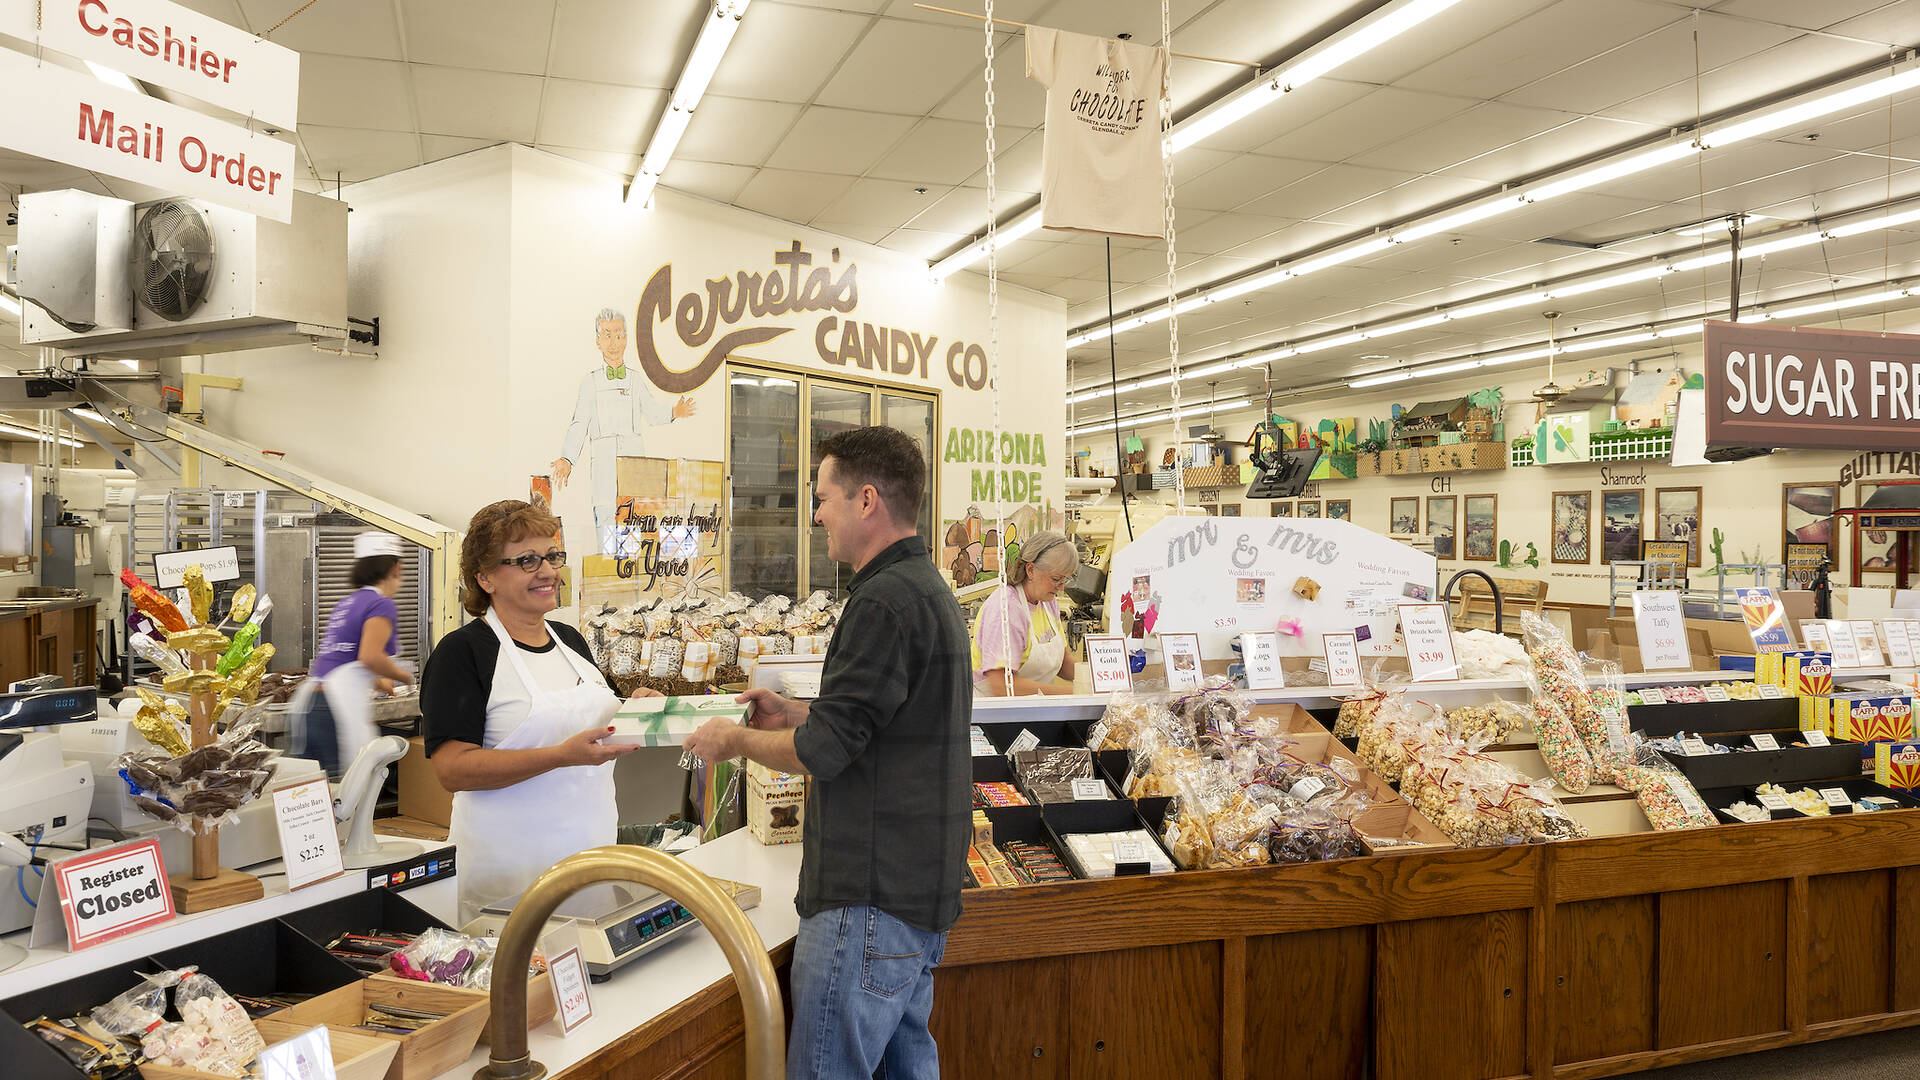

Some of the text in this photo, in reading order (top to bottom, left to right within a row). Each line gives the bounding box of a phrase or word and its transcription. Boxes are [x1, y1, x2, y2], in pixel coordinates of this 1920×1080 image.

[77, 0, 237, 84] Cashier
[1070, 88, 1145, 123] CHOCOLAE
[77, 102, 282, 196] Mail Order
[636, 240, 857, 394] Cerreta's
[815, 316, 938, 379] CANDY
[1726, 350, 1859, 419] SUGAR
[944, 427, 1047, 468] ARIZONA
[1600, 466, 1647, 486] Shamrock
[971, 470, 1042, 504] MADE
[1168, 518, 1218, 569] mr
[1267, 523, 1340, 565] mrs
[162, 559, 237, 576] Chocol Pops $1.99
[641, 539, 689, 592] Yours
[1227, 569, 1275, 578] Wedding Favors
[1357, 562, 1387, 574] Wedding
[1642, 603, 1675, 612] Southwest
[1214, 617, 1237, 628] $3.50
[1653, 617, 1670, 629] Taffy
[1655, 638, 1675, 649] $6.99
[1100, 656, 1118, 664] Gold
[1419, 651, 1444, 663] $3.99
[1097, 670, 1125, 681] $5.00
[1335, 667, 1355, 677] $2.99
[1854, 707, 1875, 715] TAFFY
[1885, 705, 1907, 713] TAFFY
[91, 728, 118, 737] SAMSUNG
[282, 798, 324, 815] Chocolate Bars
[303, 834, 308, 842] 2
[299, 844, 325, 863] $2.25
[80, 863, 145, 891] Register
[411, 867, 425, 877] VISA
[76, 883, 162, 920] Closed
[564, 991, 585, 1014] $2.99
